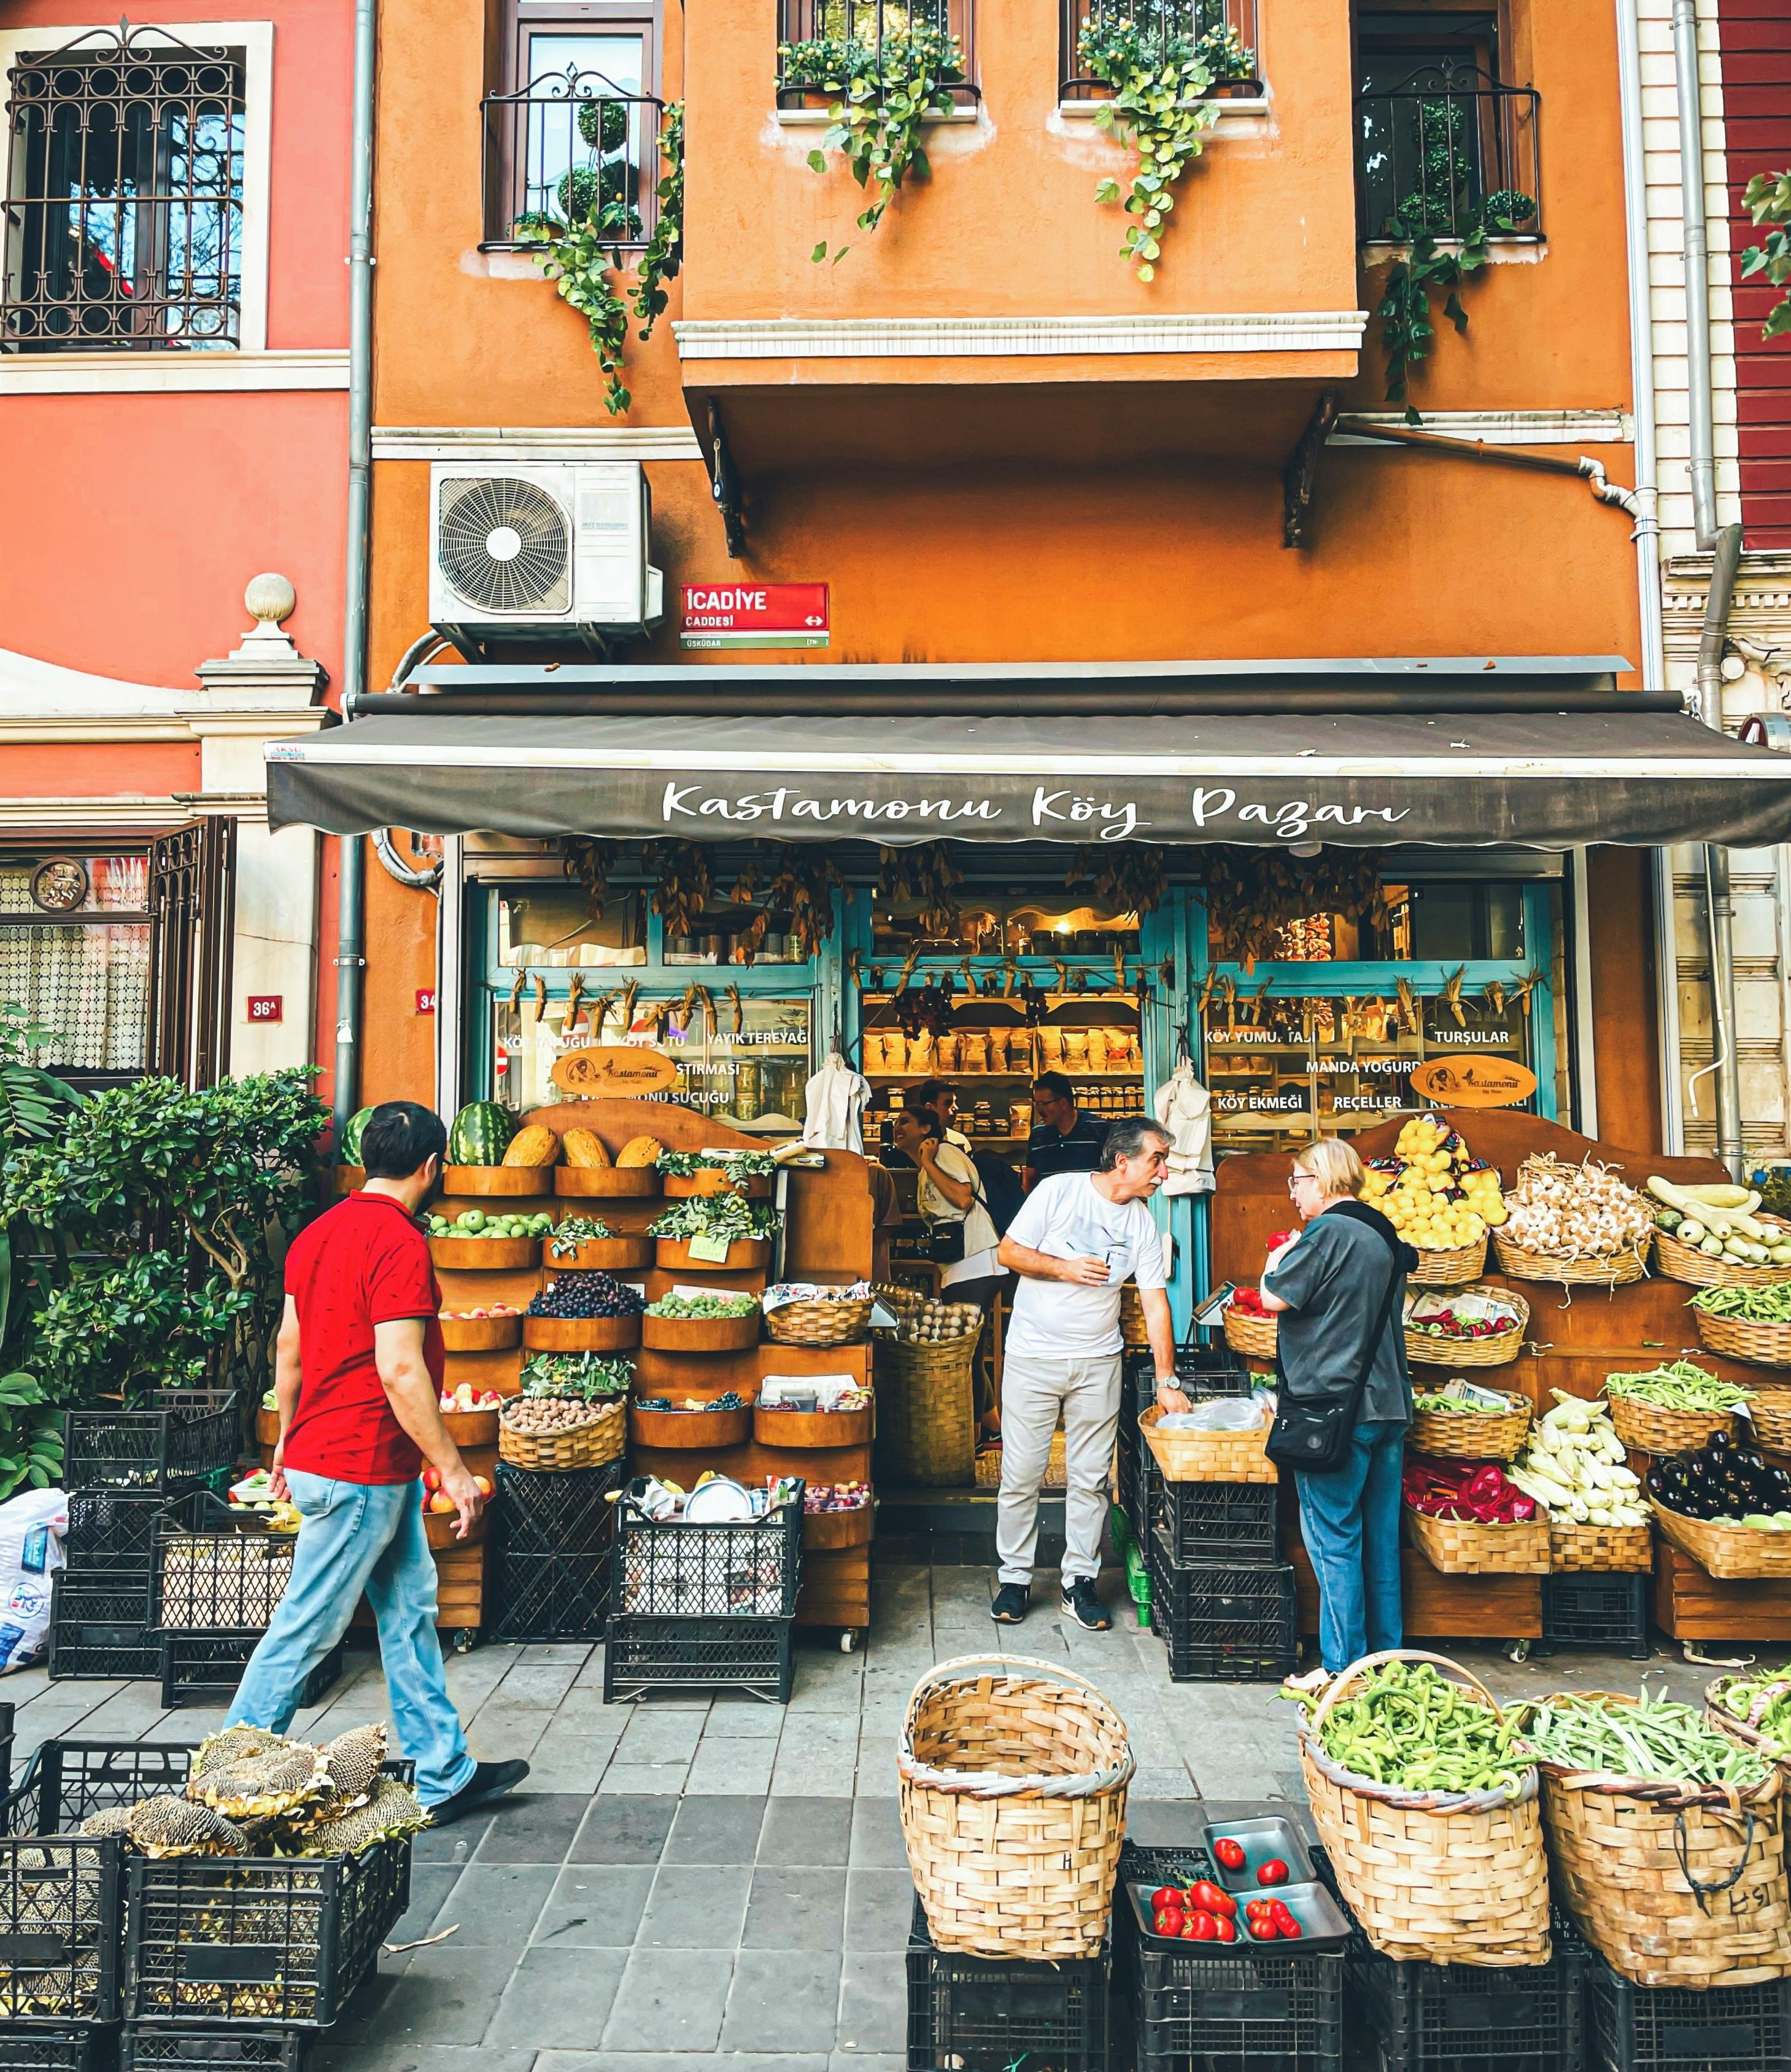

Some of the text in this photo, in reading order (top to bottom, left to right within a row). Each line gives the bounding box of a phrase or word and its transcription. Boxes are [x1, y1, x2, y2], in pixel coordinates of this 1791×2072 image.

[687, 588, 767, 610] İCADİYE
[686, 615, 733, 627] CADDESİ
[687, 638, 721, 647] ÜSKÜDAR
[663, 782, 1410, 839] Kastamonu Köy Pazarı
[707, 1033, 745, 1044] YAYIK
[1204, 1028, 1316, 1043] KÖY YUMUTAI
[1434, 1031, 1509, 1046] TURŞULAR
[676, 1063, 740, 1075] STIRMASI
[1306, 1058, 1423, 1074] MANDA YOĞURD
[672, 1089, 730, 1104] SUCUĞU
[1218, 1094, 1302, 1109] KÖY EKMEĞİ
[1334, 1096, 1402, 1111] REÇELLER
